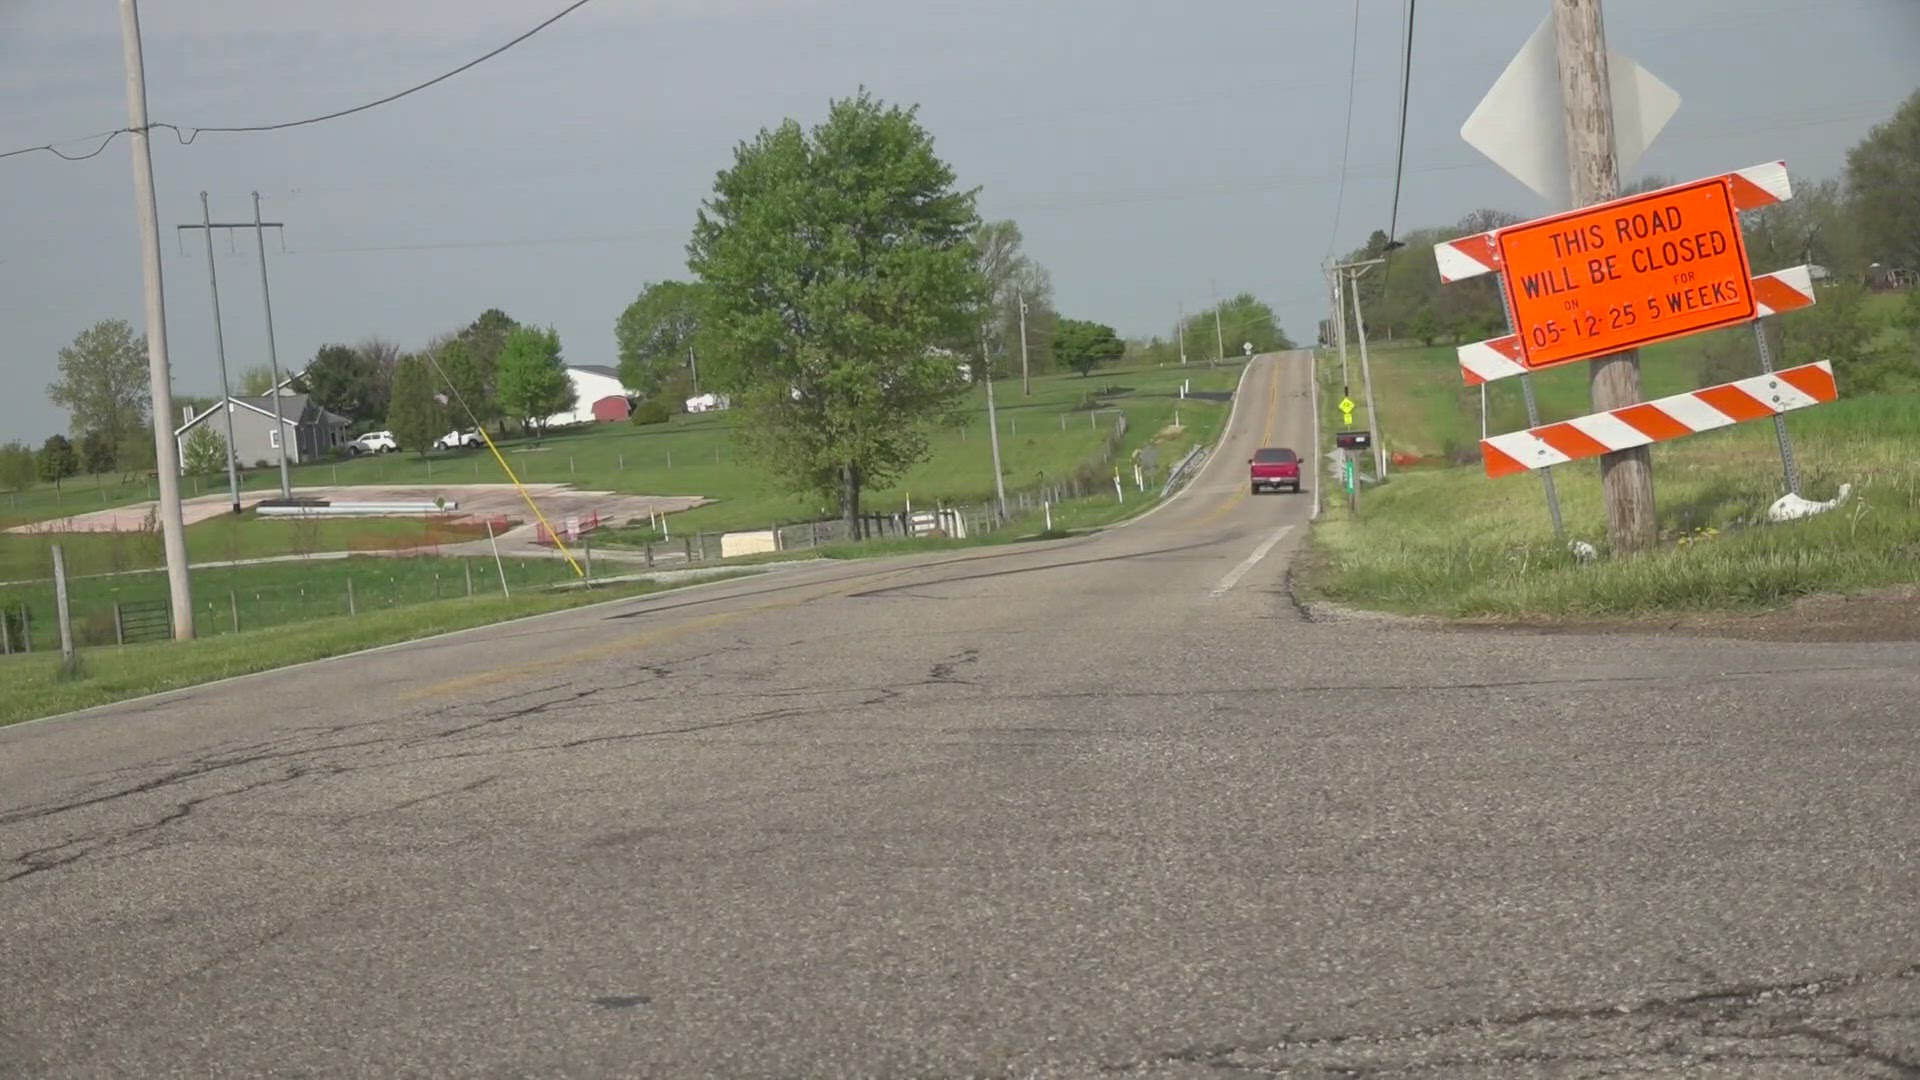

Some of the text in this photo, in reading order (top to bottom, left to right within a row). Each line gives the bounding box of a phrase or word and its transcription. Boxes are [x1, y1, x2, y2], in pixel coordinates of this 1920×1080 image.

[1550, 206, 1682, 258] THIS ROAD
[1521, 231, 1726, 299] WILL BE CLOSED
[1674, 271, 1694, 284] FOR
[1564, 299, 1578, 311] ON
[1648, 299, 1660, 318] 5
[1666, 281, 1738, 314] WEEKS
